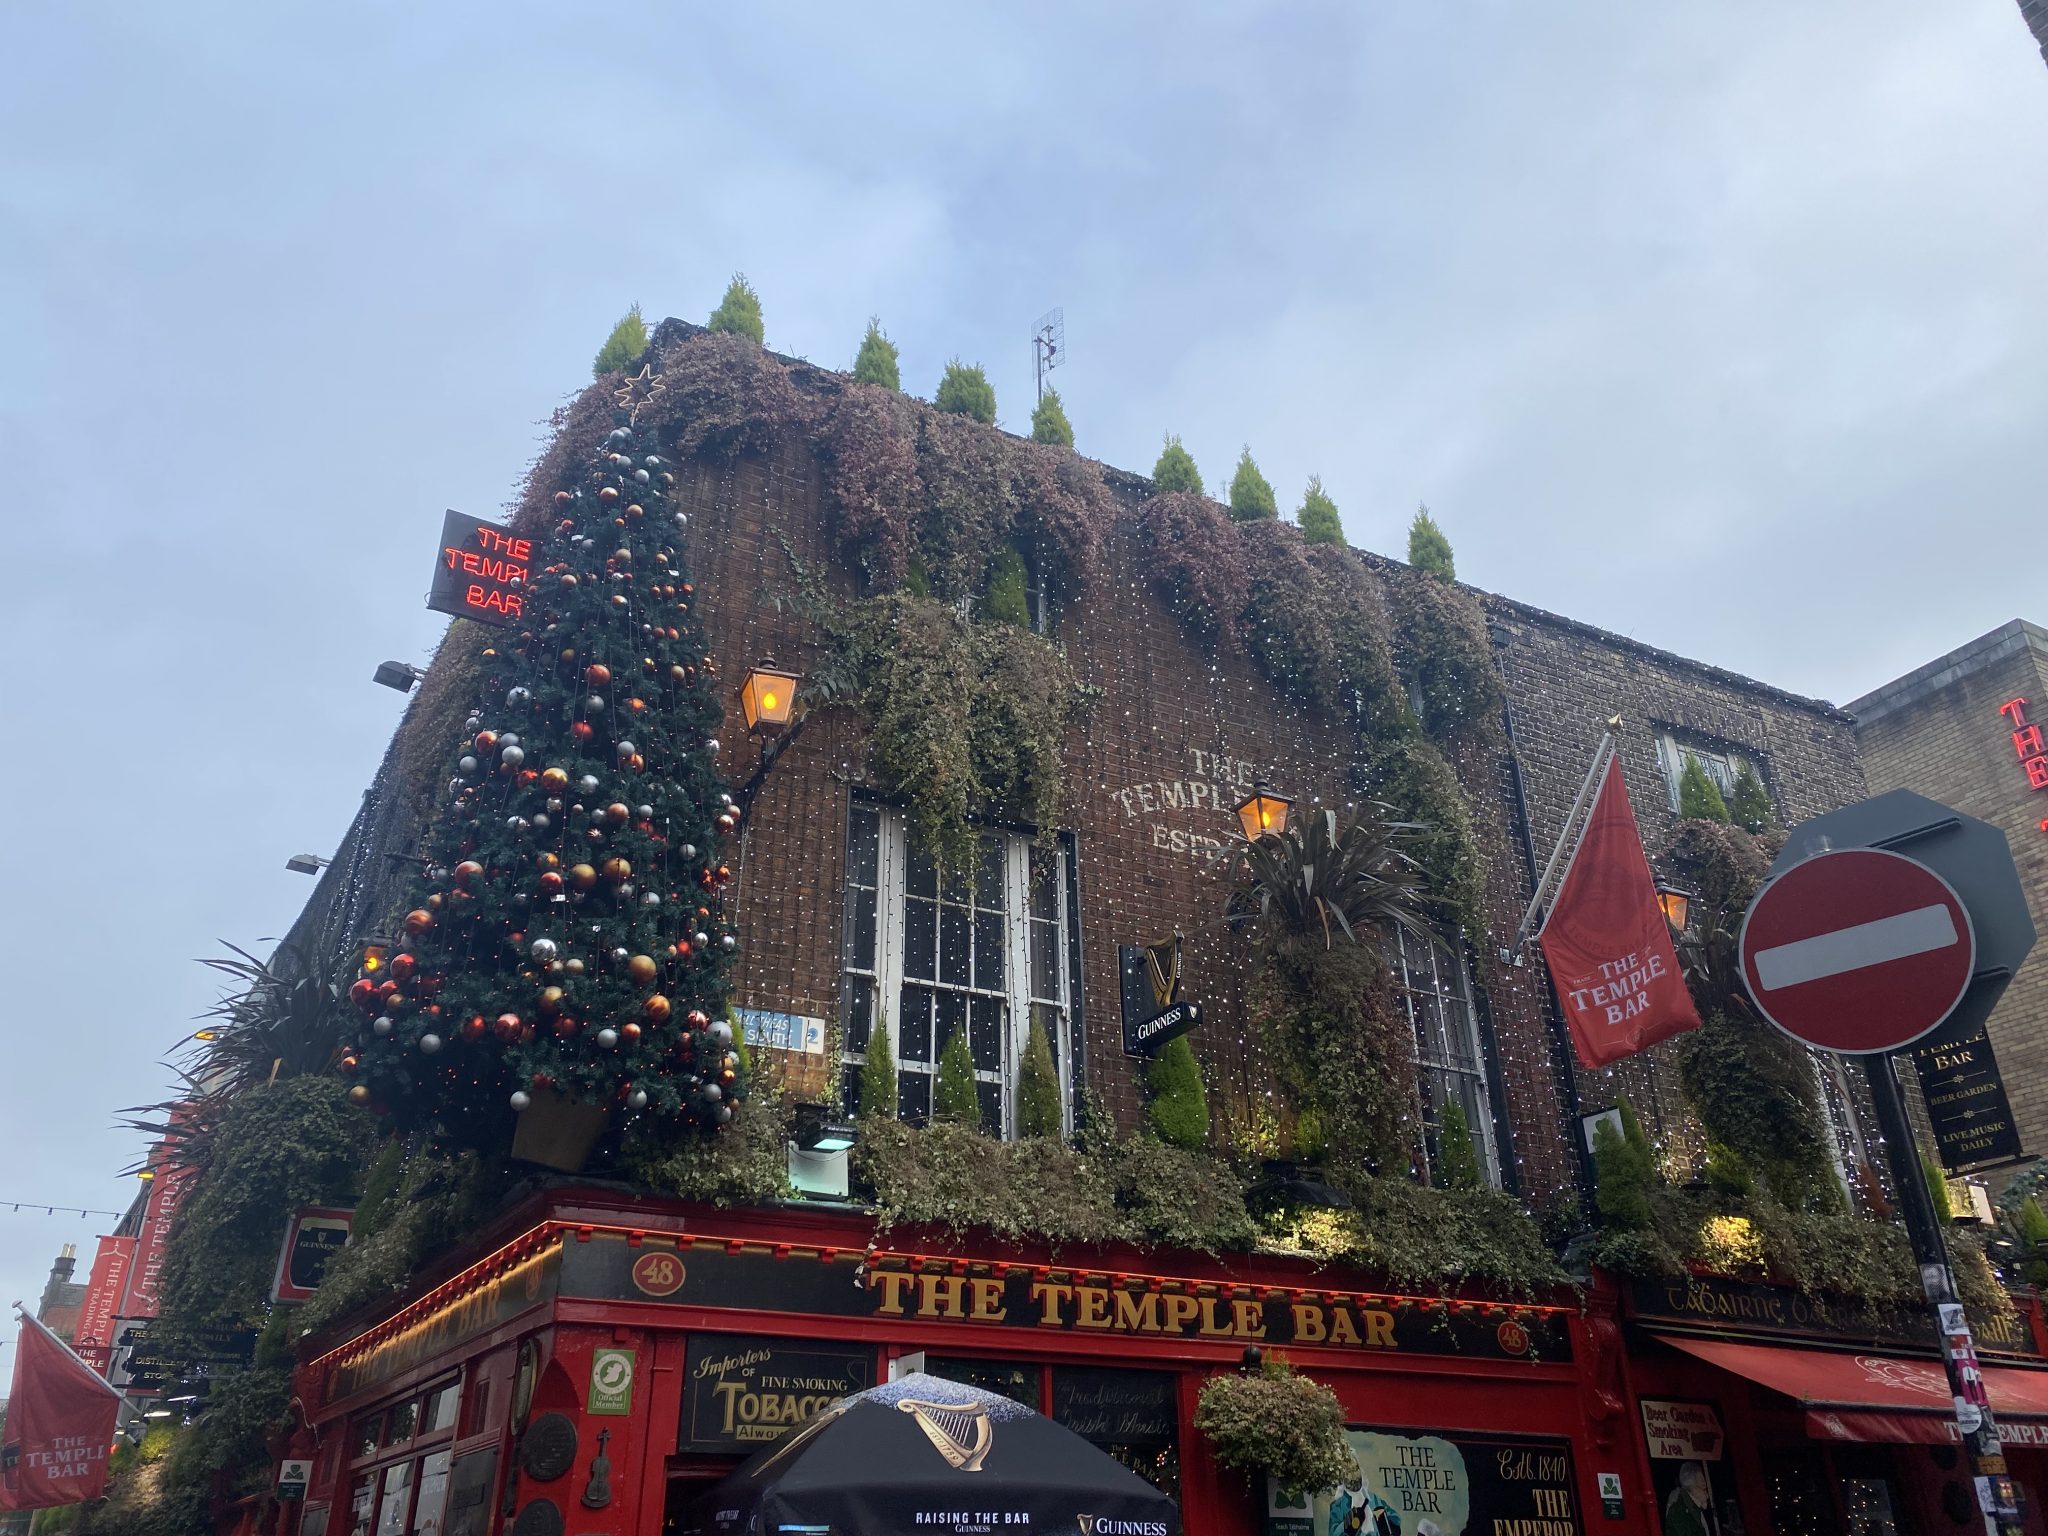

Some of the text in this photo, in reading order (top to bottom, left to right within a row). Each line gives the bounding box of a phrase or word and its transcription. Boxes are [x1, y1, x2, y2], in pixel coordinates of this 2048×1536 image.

[478, 527, 531, 561] THE
[445, 548, 529, 584] TEMPL
[466, 585, 522, 617] BAR
[2000, 697, 2048, 789] THE
[1189, 748, 1254, 787] THE
[1111, 781, 1245, 818] TEMPL
[1598, 953, 1638, 979] THE
[1569, 955, 1666, 1011] TEMPLE
[1606, 991, 1650, 1025] BAR
[1138, 1007, 1181, 1040] GUINNESS
[747, 1029, 792, 1045] SOUTH
[1935, 1050, 1975, 1070] BAR
[1931, 1083, 1998, 1106] BEER GARDEN
[1943, 1121, 2007, 1144] LIVE MUSIC
[1961, 1136, 1994, 1152] DAILY
[106, 1260, 123, 1287] THE
[142, 1251, 163, 1290] THE
[641, 1258, 674, 1285] 48
[83, 1287, 101, 1330] TRADING
[869, 1271, 1398, 1348] THE TEMPLE BAR
[130, 1329, 146, 1338] THE
[1502, 1327, 1522, 1347] 48
[78, 1349, 97, 1358] THE
[693, 1348, 771, 1381] Importers
[144, 1372, 174, 1380] STO
[742, 1367, 756, 1377] OF
[761, 1376, 848, 1391] FINE SMOKING
[595, 1400, 625, 1409] Member
[598, 1394, 623, 1402] Official
[713, 1381, 845, 1434] TOBACC
[1644, 1404, 1668, 1421] Beer
[53, 1436, 87, 1449] THE
[1647, 1422, 1690, 1442] Smoking
[2000, 1424, 2048, 1445] EMPL
[1396, 1445, 1436, 1468] THE
[1660, 1440, 1684, 1457] Area
[47, 1462, 89, 1479] BAR
[1379, 1467, 1456, 1491] TEMPLE
[1538, 1455, 1566, 1482] 1840
[1401, 1490, 1442, 1514] BAR
[1532, 1489, 1571, 1518] THE
[916, 1512, 1030, 1524] RAISING THE BAR
[955, 1524, 990, 1533] GUINNESS
[1096, 1518, 1167, 1536] GUINNESS
[1493, 1519, 1574, 1536] EMPEROR
